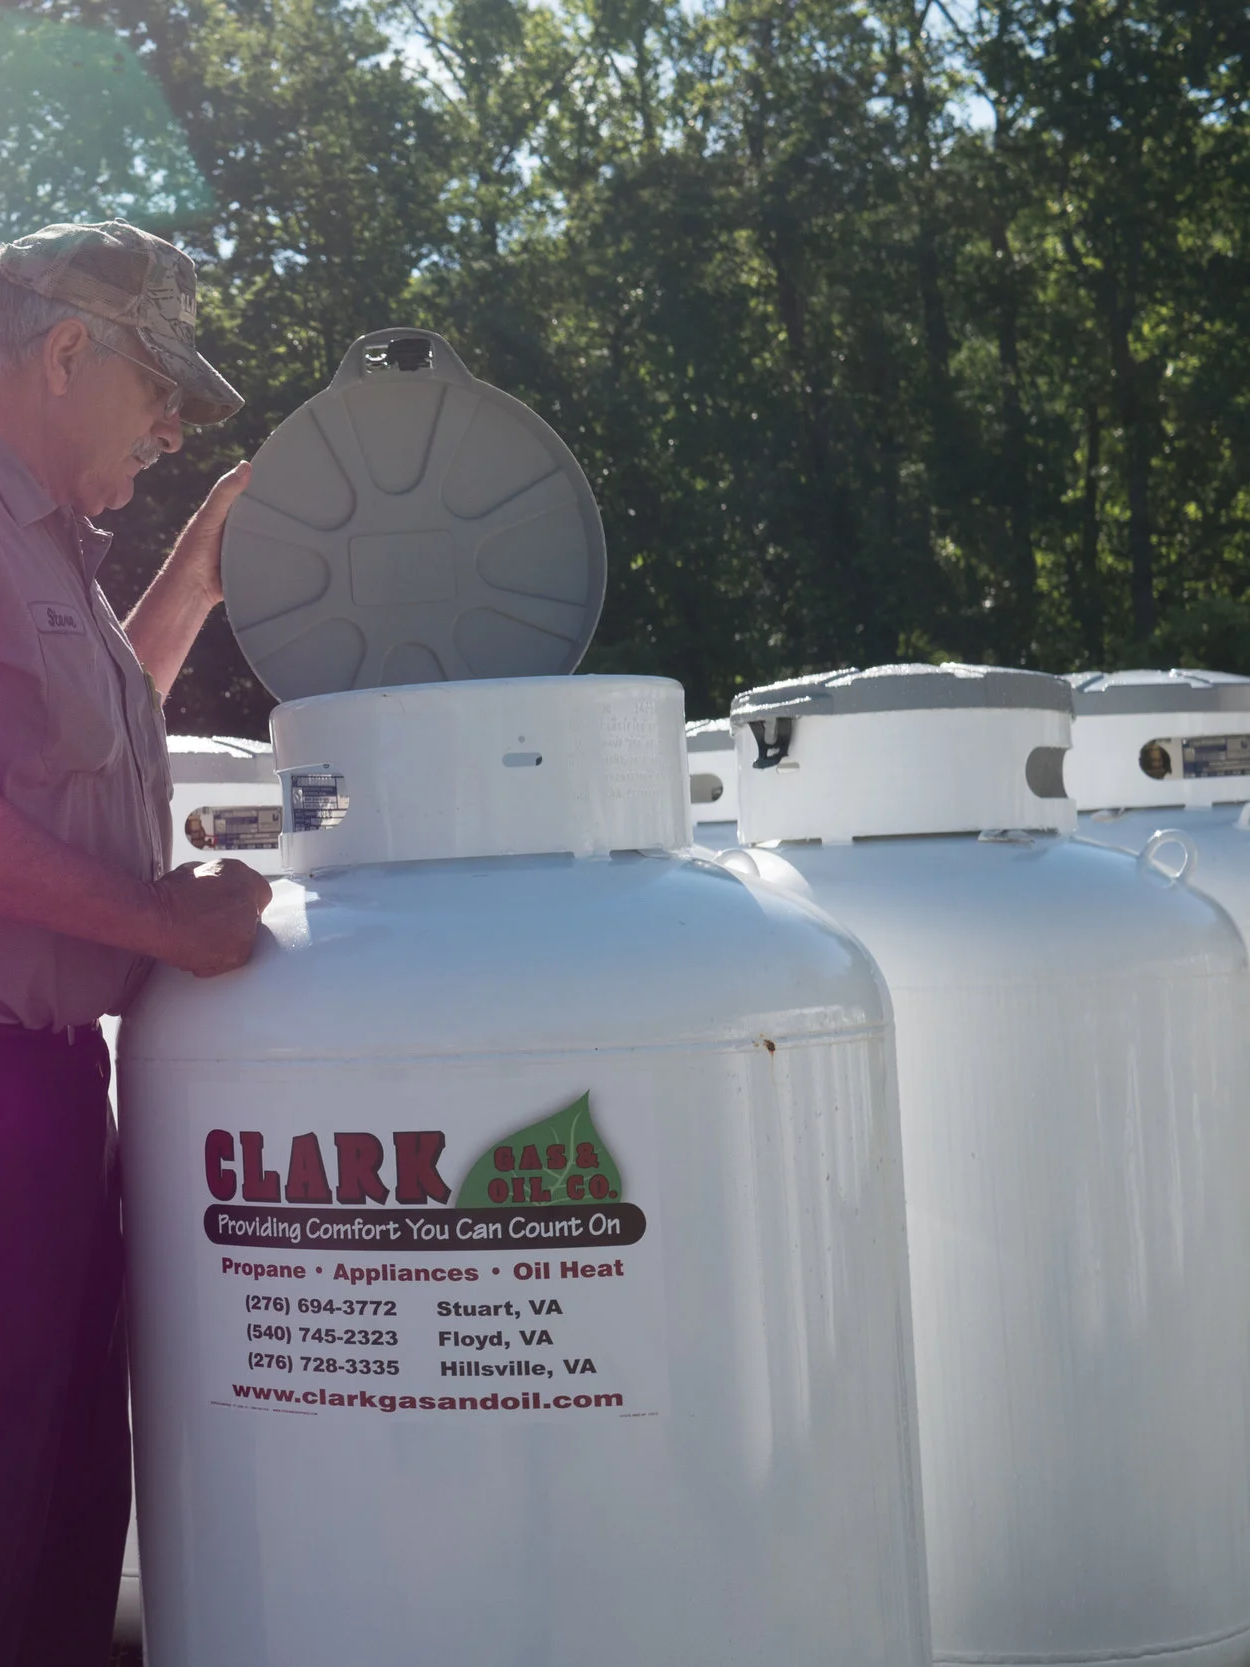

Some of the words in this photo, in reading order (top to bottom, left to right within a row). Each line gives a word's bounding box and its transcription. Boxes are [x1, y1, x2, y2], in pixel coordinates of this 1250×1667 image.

[204, 1129, 451, 1205] CLARK
[487, 1176, 552, 1203] OIL
[567, 1174, 618, 1200] CO.
[218, 1214, 301, 1243] Providing
[306, 1218, 402, 1240] Comfort
[406, 1218, 450, 1240] You
[456, 1218, 502, 1240] Can
[508, 1214, 583, 1238] Count
[588, 1211, 621, 1235] On
[221, 1257, 306, 1281] Propane
[333, 1263, 479, 1285] Appliances
[513, 1261, 550, 1281] Oil
[560, 1259, 624, 1279] Heat
[245, 1294, 290, 1315] (276)
[297, 1297, 397, 1317] 694-3772
[436, 1300, 521, 1320] Stuart,
[528, 1299, 563, 1316] VA
[246, 1323, 292, 1344] (540)
[298, 1326, 398, 1347] 745-2323
[438, 1331, 511, 1350] Floyd,
[519, 1329, 554, 1346] VA
[248, 1352, 293, 1373] (276)
[300, 1355, 400, 1376] 728-3335
[440, 1360, 553, 1379] Hillsville,
[563, 1358, 597, 1375] VA
[232, 1384, 624, 1414] www.clarkgasandoil.com
